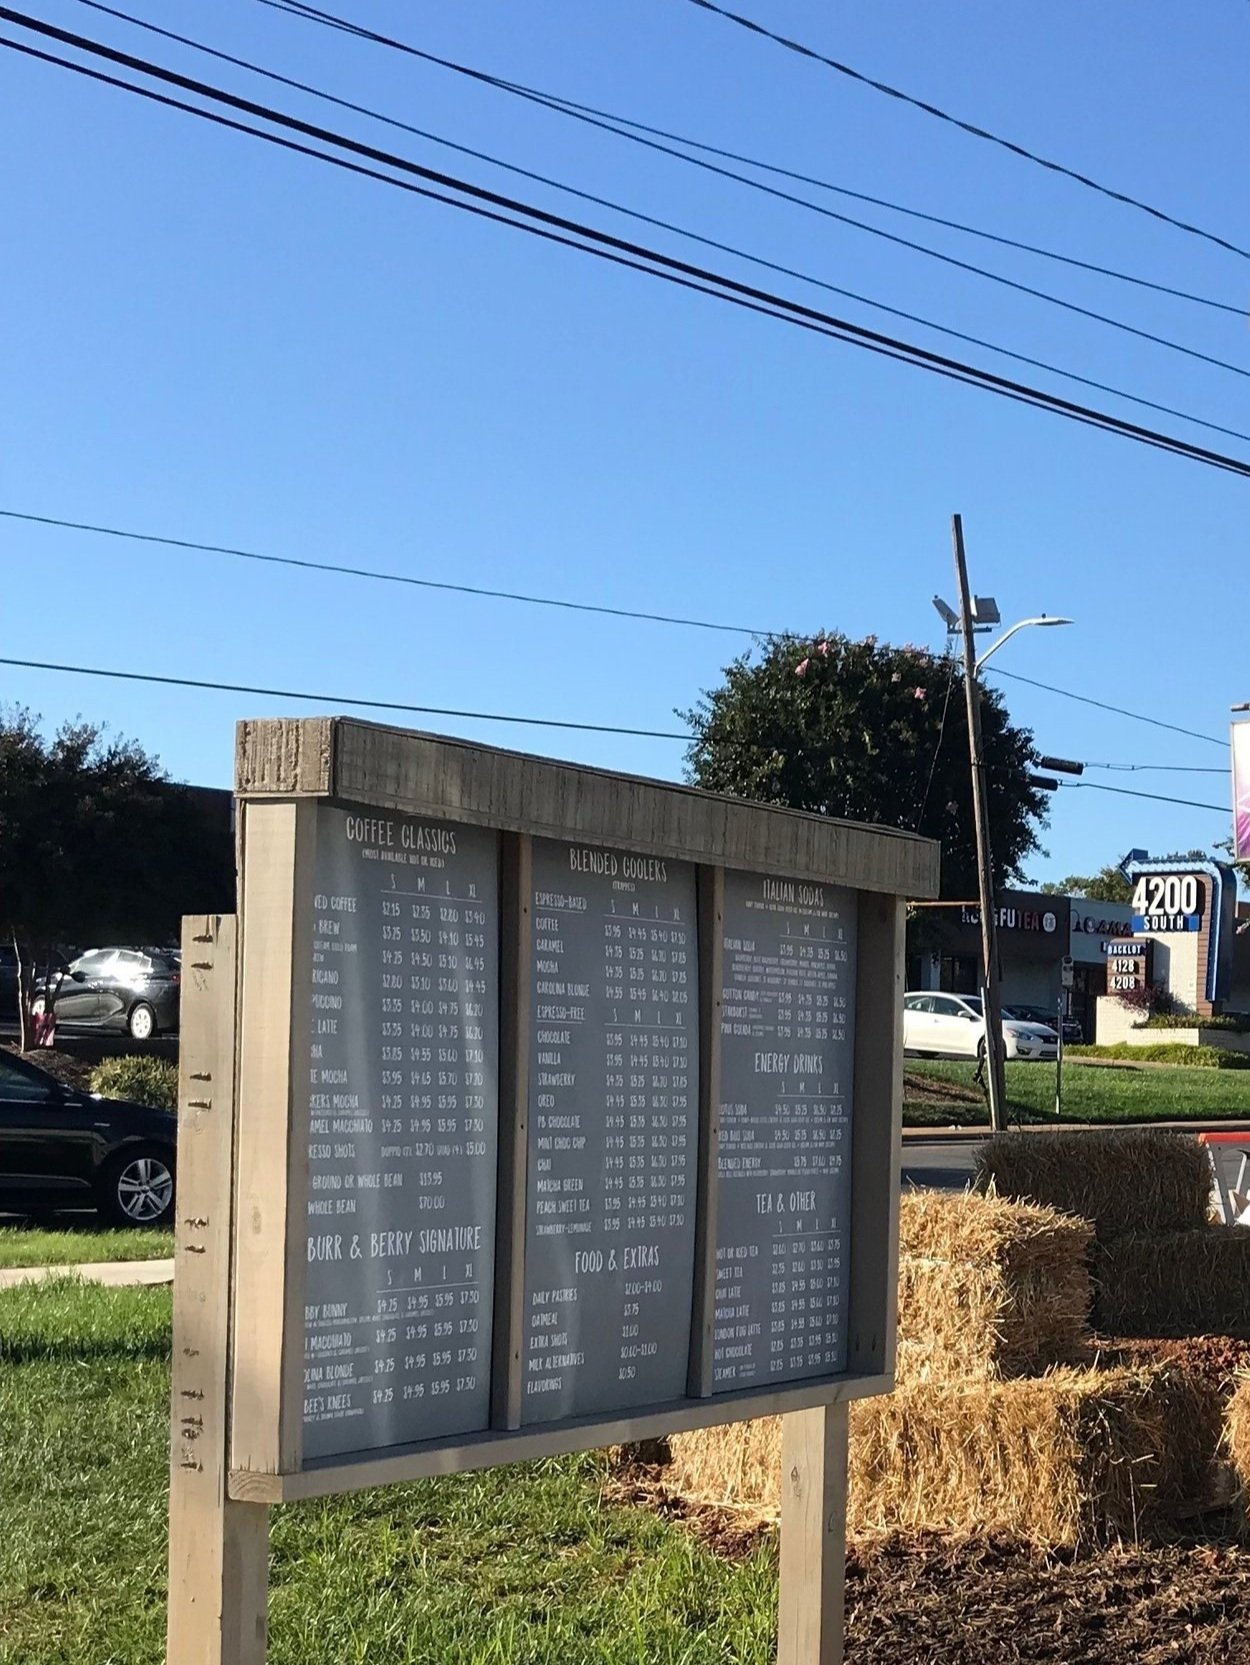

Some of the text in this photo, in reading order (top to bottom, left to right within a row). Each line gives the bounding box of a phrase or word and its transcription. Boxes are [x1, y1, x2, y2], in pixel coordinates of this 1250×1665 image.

[346, 816, 456, 854] COFFEE CLASSICS
[570, 848, 667, 882] BLENDED COOLERS
[418, 877, 425, 892] M
[446, 880, 450, 895] L
[469, 884, 476, 898] XL
[763, 879, 824, 907] ITALIAN SODAS
[535, 892, 587, 910] ESPRESSO-BASED
[1132, 875, 1197, 915] 4200
[331, 896, 357, 913] COFFEE
[632, 902, 639, 916] M
[319, 920, 340, 935] BREW
[536, 917, 558, 931] COFFEE
[1144, 916, 1183, 930] SOUTH
[536, 939, 564, 953] CARAMEL
[1108, 945, 1141, 954] BACKLOT
[537, 960, 558, 973] MOCHA
[1112, 960, 1134, 972] 4128
[1111, 976, 1135, 989] 4208
[537, 1005, 585, 1020] ESPRESSO-FREE
[635, 1010, 641, 1022] M
[318, 1019, 337, 1034] LATTE
[537, 1030, 571, 1044] CHOCOLATE
[538, 1052, 561, 1065] VANILLA
[755, 1053, 823, 1074] ENERGY DRINKS
[322, 1070, 347, 1084] MOCHA
[538, 1073, 576, 1087] STRAWBERRY
[333, 1095, 359, 1108] MOCHA
[538, 1095, 555, 1108] OREO
[333, 1119, 373, 1133] MACCHIATO
[548, 1115, 580, 1128] CHOCOLATE
[538, 1137, 552, 1149] MINT
[334, 1144, 355, 1158] SHOTS
[312, 1175, 342, 1189] GROUND
[345, 1175, 354, 1189] OR
[358, 1174, 380, 1188] WHOLE
[384, 1173, 402, 1187] BEAN
[563, 1179, 583, 1191] GREEN
[308, 1200, 332, 1215] WHOLE
[336, 1199, 356, 1214] BEAN
[536, 1199, 590, 1214] PEACH SWEET TEA
[756, 1191, 816, 1214] TEA & OTHER
[308, 1226, 481, 1262] BURR & BERRY SIGNATURE
[575, 1246, 659, 1273] FOOD & EXTRAS
[414, 1267, 422, 1282] M
[532, 1292, 548, 1305] DAILY
[532, 1312, 558, 1327] OATMEAL
[530, 1333, 568, 1349] EXTRA SHOTS
[529, 1358, 543, 1371] MILK
[326, 1363, 354, 1381] BLONDE
[327, 1394, 351, 1410] KNEES
